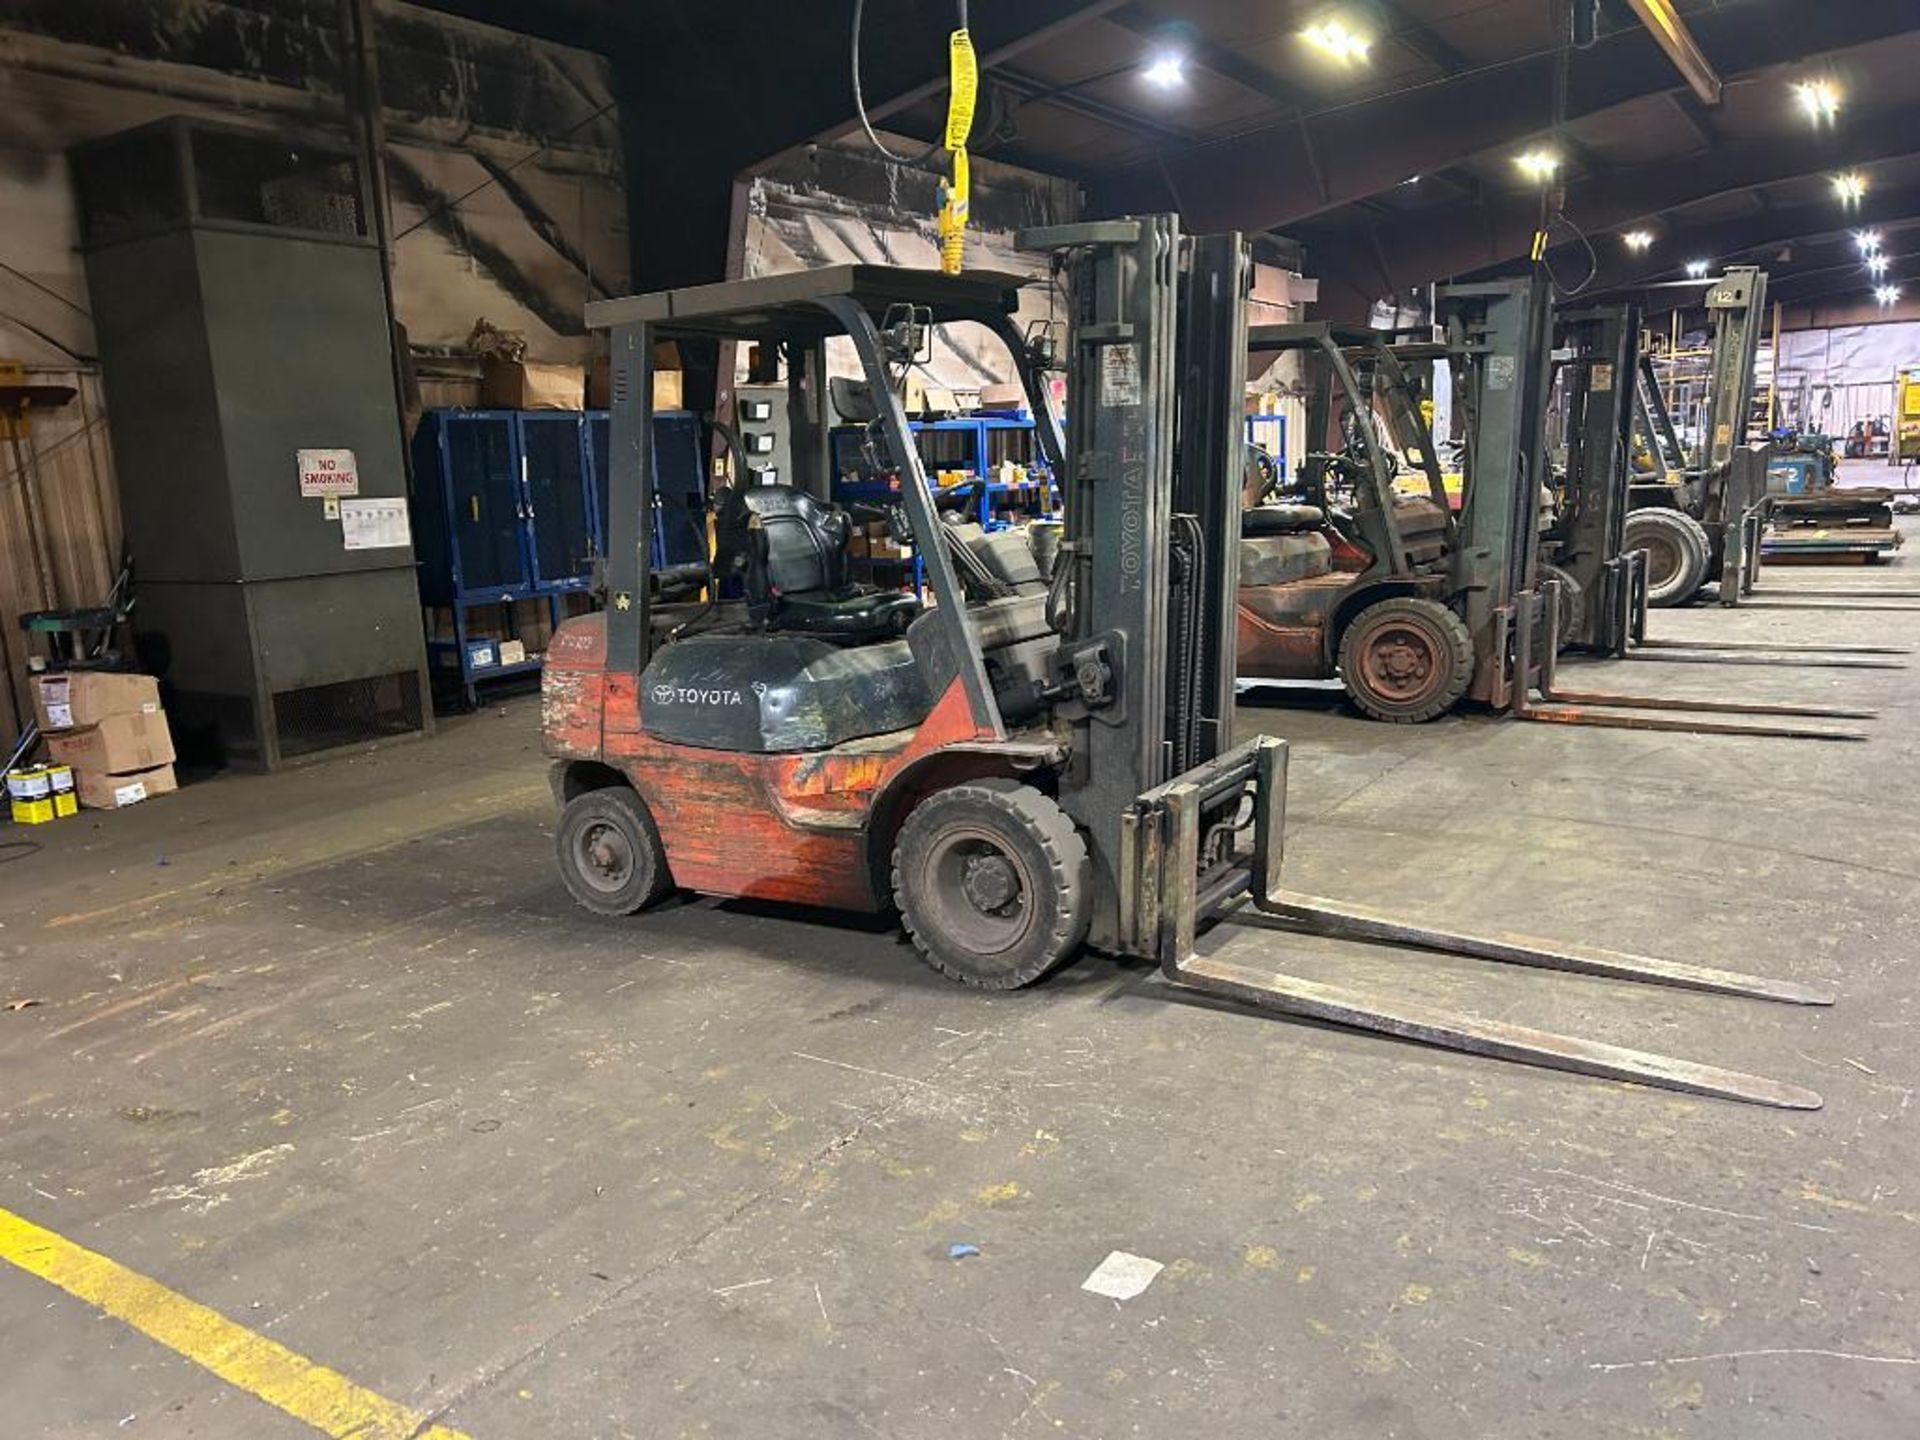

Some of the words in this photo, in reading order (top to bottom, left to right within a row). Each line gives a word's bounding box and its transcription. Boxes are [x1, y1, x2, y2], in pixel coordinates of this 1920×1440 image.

[318, 460, 336, 470] NO
[304, 473, 353, 484] SMOKING
[1120, 469, 1143, 595] TOYOTA
[677, 688, 743, 705] TOYOTA
